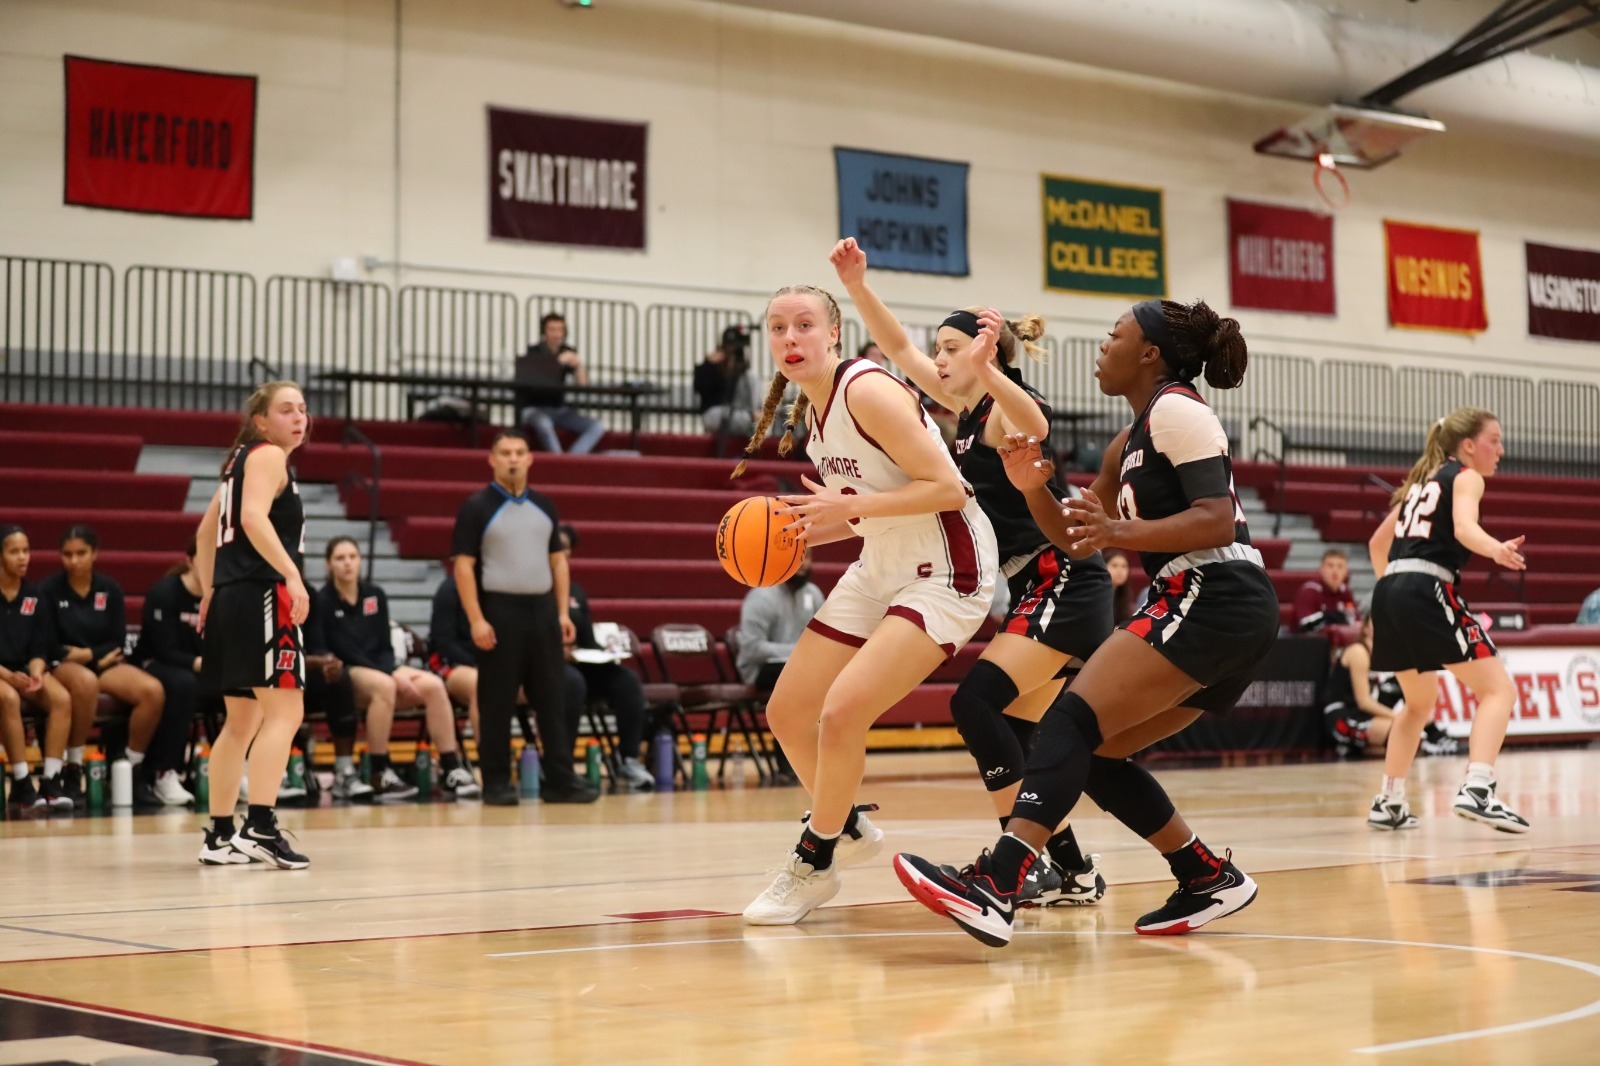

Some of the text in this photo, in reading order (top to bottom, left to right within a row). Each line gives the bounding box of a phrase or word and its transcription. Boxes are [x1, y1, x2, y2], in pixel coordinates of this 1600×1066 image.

[88, 107, 232, 171] HAVERFORD
[498, 149, 638, 211] SWARTHMORE
[866, 170, 939, 209] JOHNS
[857, 217, 949, 257] HOPKINS
[1047, 197, 1159, 236] McDANIEL
[1051, 242, 1158, 279] COLLEGE
[1394, 256, 1472, 301] URSINUS
[1395, 481, 1441, 539] 32
[718, 515, 731, 560] NCAA
[277, 650, 296, 670] H
